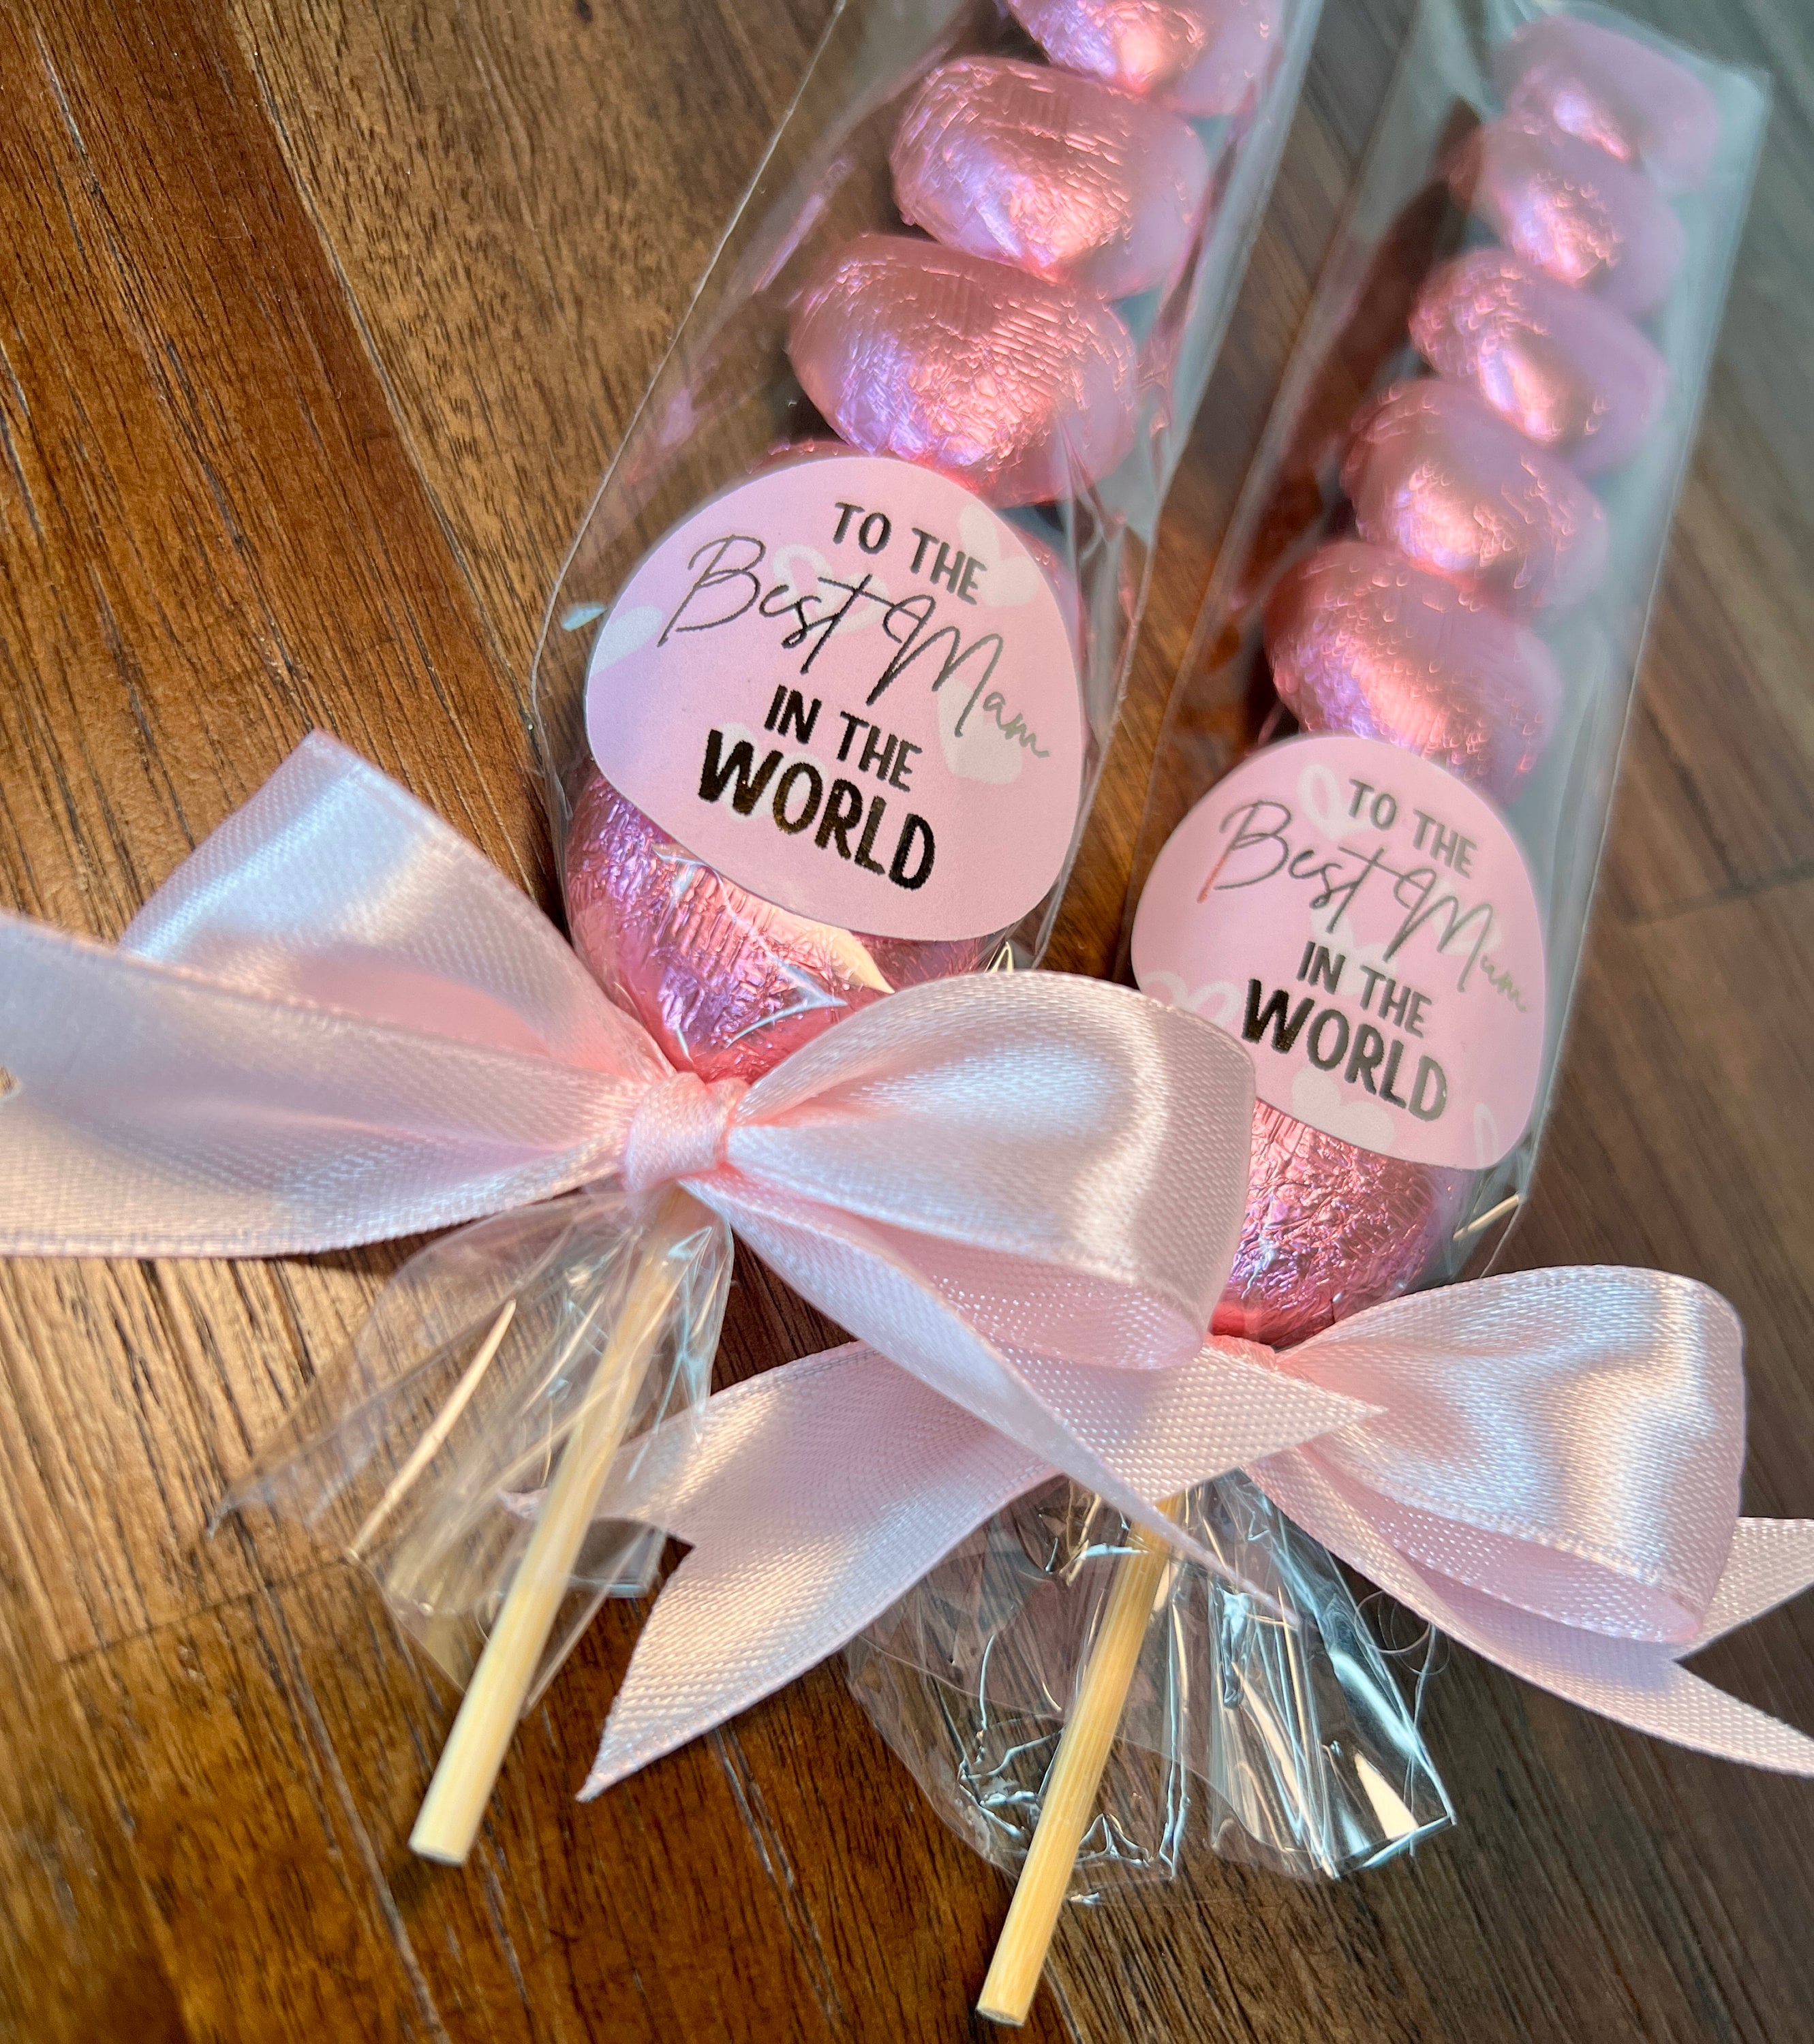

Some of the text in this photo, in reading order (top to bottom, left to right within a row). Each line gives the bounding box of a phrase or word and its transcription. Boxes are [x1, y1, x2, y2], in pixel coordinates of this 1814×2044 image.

[657, 534, 917, 673] Best
[834, 502, 987, 606] TO THE
[764, 685, 923, 792] IN THE
[698, 728, 936, 891] WORLD
[1197, 800, 1406, 933] Best
[1349, 778, 1477, 880] TO THE
[1297, 941, 1432, 1038] IN THE
[1241, 978, 1447, 1122] WORLD
